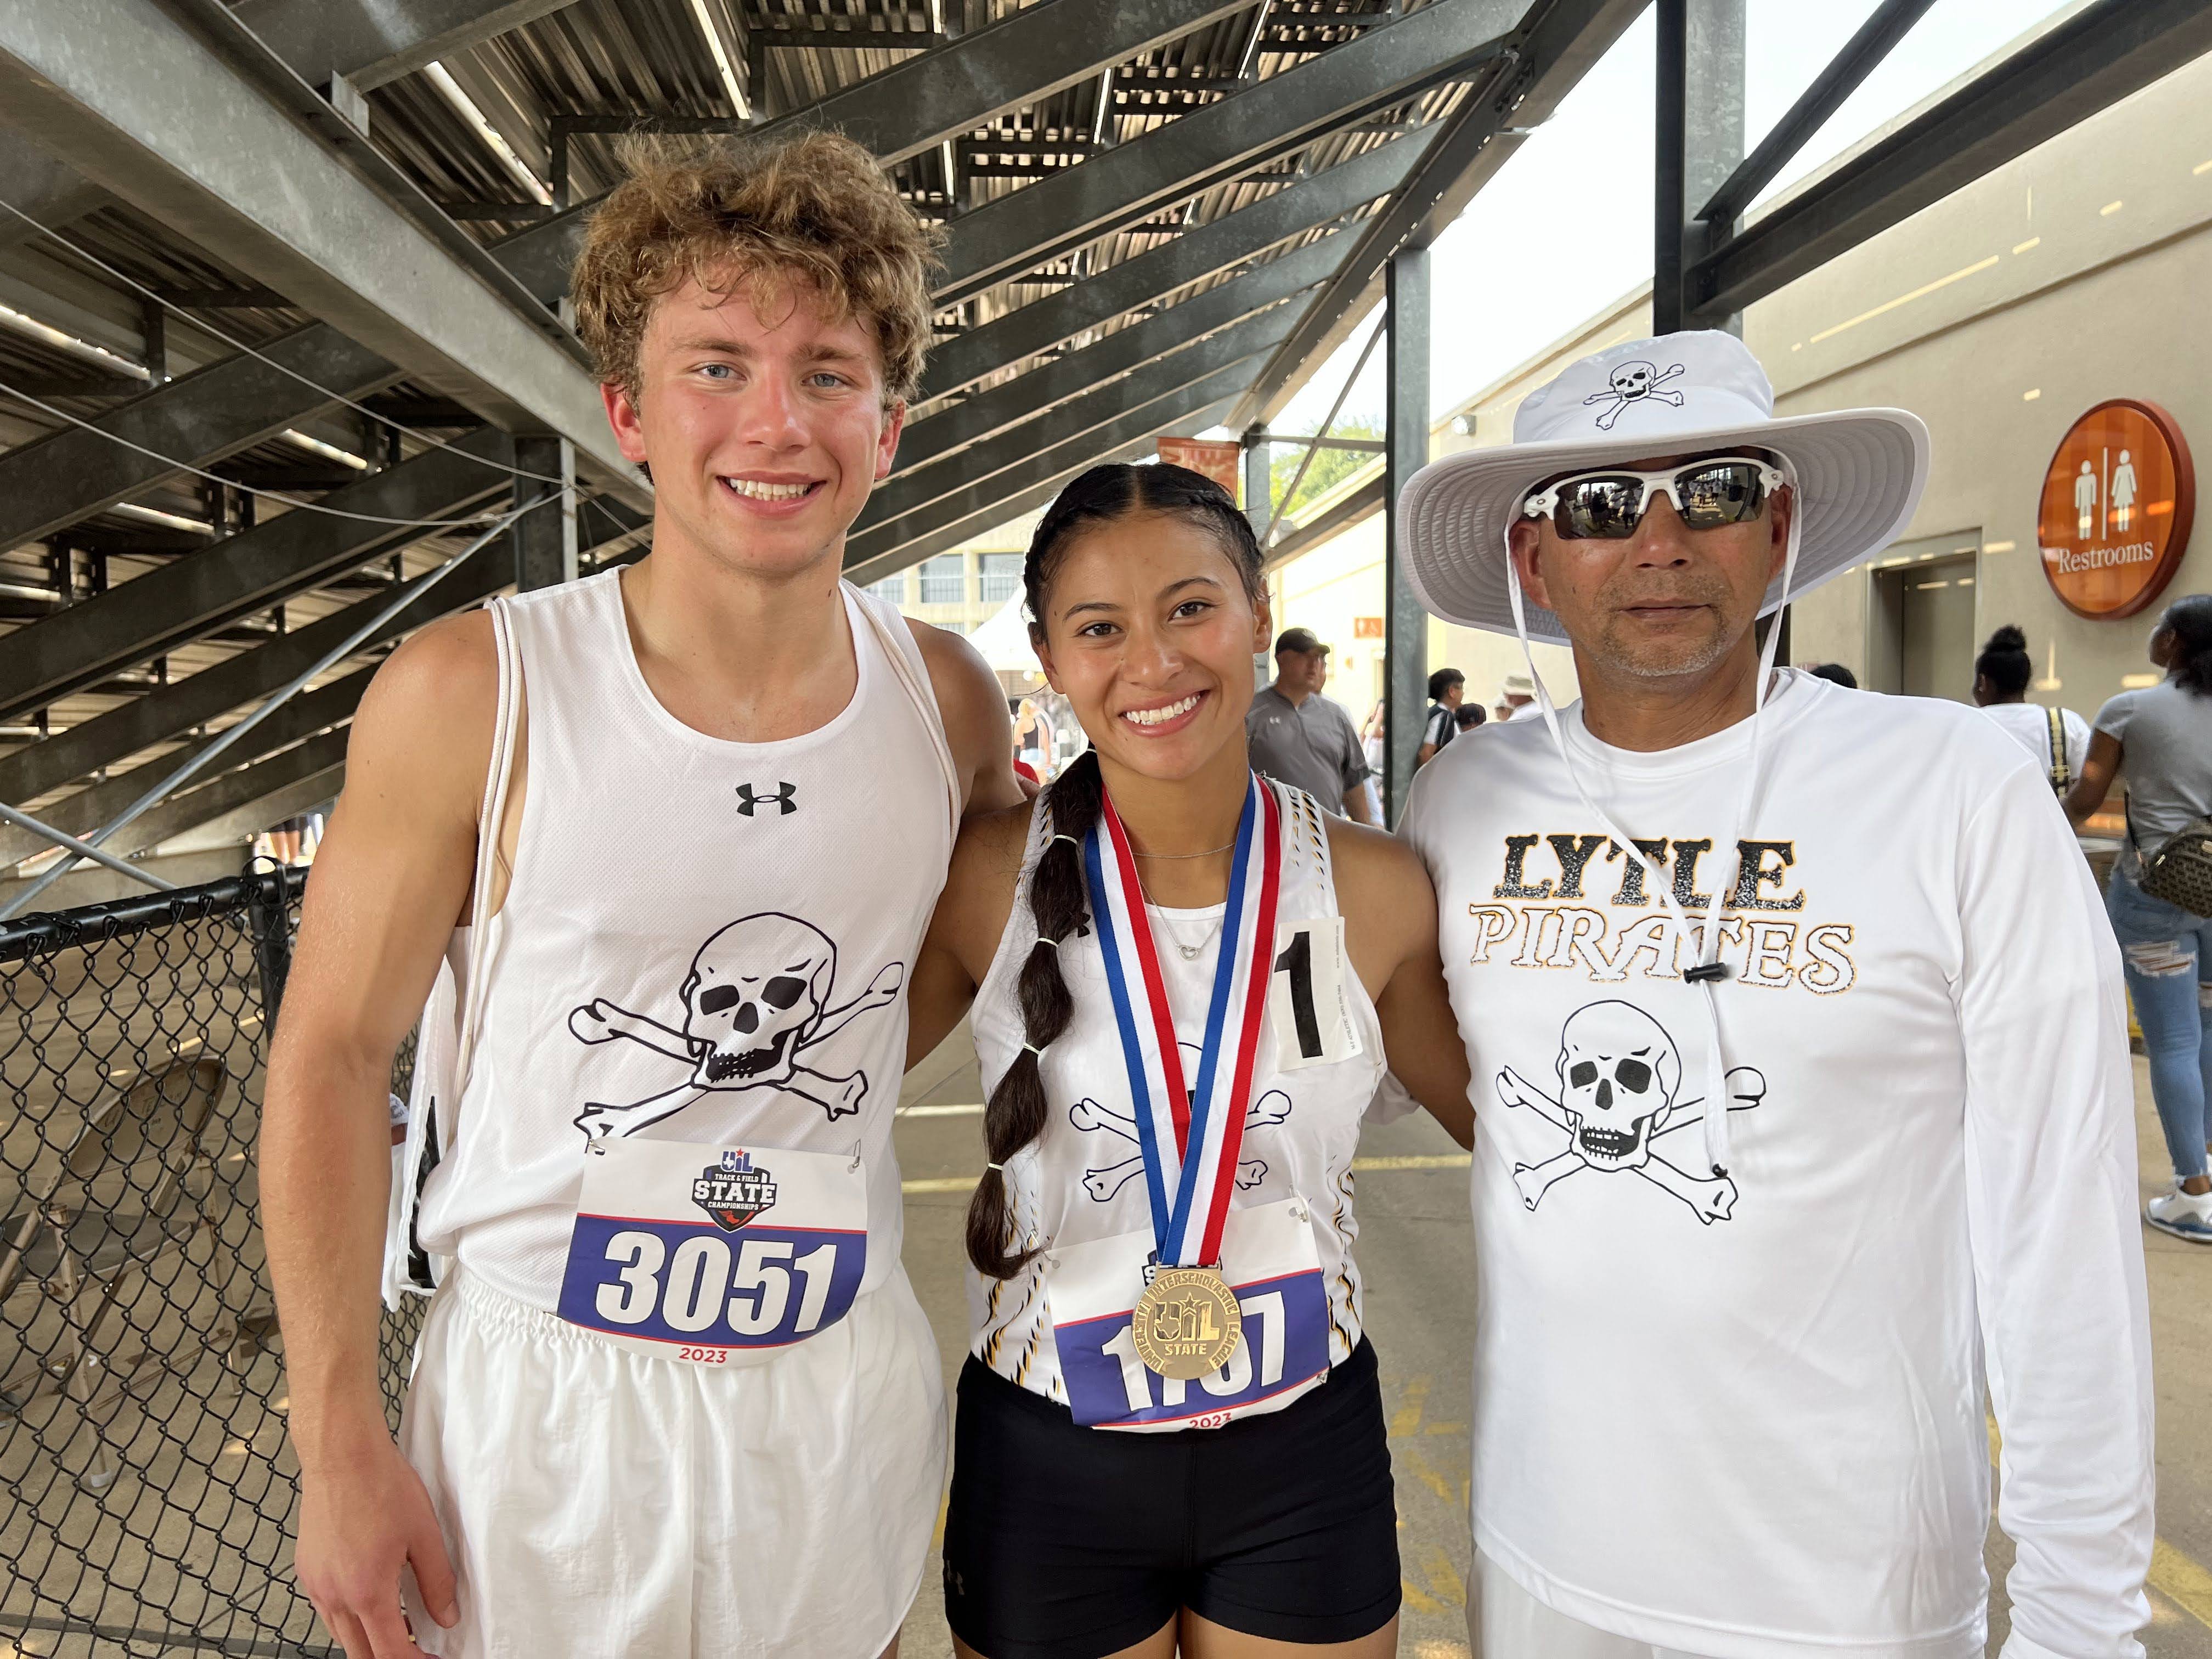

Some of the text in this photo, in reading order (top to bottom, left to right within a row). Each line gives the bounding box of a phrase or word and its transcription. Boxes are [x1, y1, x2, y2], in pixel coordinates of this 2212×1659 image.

[2058, 541, 2154, 574] Restrooms
[1493, 834, 1805, 911] LYTLE
[1470, 904, 1856, 995] PIRATES
[1274, 931, 1323, 1058] 1
[720, 1151, 753, 1173] UIL
[715, 1173, 736, 1182] TRACK
[693, 1180, 776, 1204] STATE
[707, 1201, 759, 1211] CHAMPIONSHIPS
[595, 1231, 838, 1336] 3051
[1153, 1300, 1220, 1341] UIL
[679, 1347, 727, 1364] 2023
[1164, 1342, 1207, 1356] STATE
